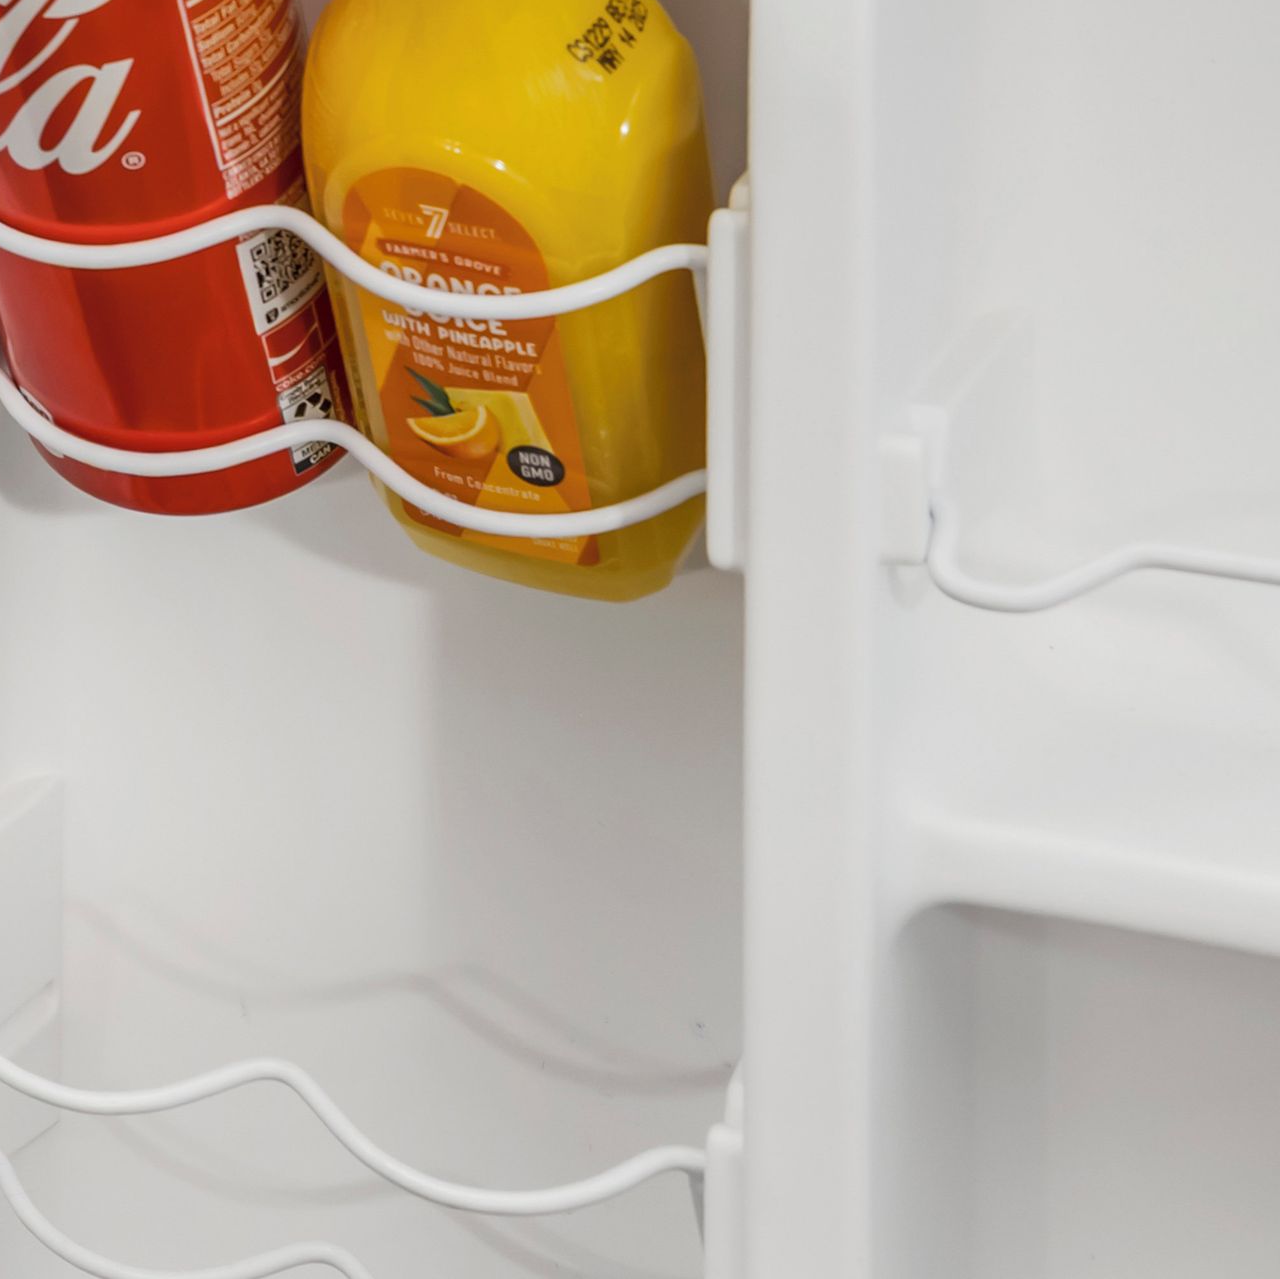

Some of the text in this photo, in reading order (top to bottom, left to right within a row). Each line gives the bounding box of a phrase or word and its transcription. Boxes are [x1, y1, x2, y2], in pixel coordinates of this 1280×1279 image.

[418, 203, 449, 239] 7
[454, 255, 501, 276] GROVE
[382, 310, 538, 358] WITH PINEAPPLE
[446, 345, 493, 368] Natural
[448, 362, 480, 380] Juice
[482, 370, 519, 387] Blend
[309, 445, 332, 465] CAN
[518, 451, 552, 468] NON
[433, 465, 464, 486] From
[466, 476, 541, 502] Concentrate
[521, 465, 555, 483] GMO
